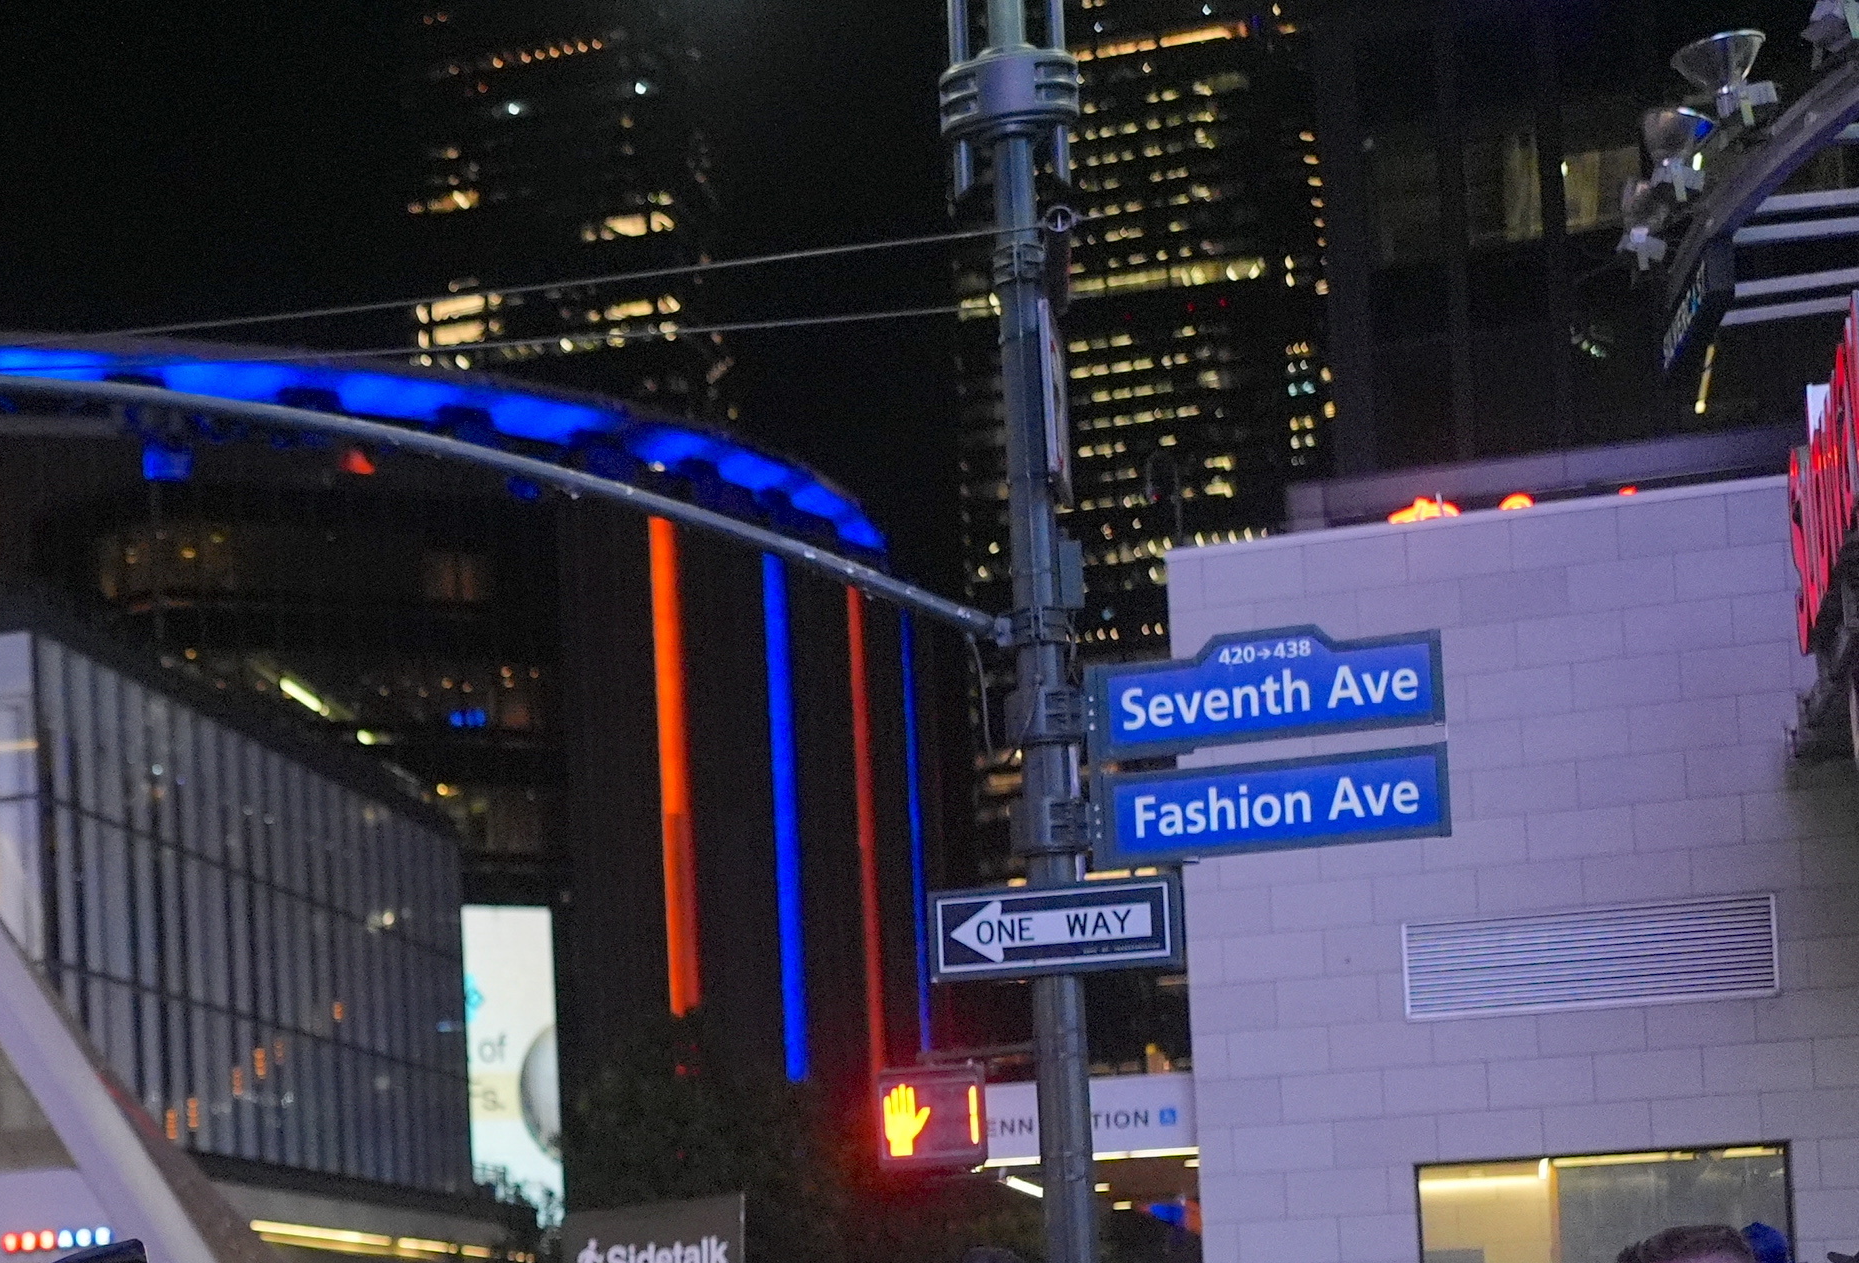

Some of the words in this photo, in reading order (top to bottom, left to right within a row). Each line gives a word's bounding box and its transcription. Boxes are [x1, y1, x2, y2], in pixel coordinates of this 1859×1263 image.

[1218, 646, 1256, 665] 420
[1273, 640, 1311, 658] 438
[1121, 668, 1311, 731] Seventh
[1327, 665, 1419, 709] Ave
[1134, 785, 1312, 838] Fashion
[1328, 777, 1420, 820] Ave
[976, 918, 1035, 945] ONE
[1066, 909, 1131, 938] WAY
[987, 1116, 1034, 1138] ENN
[1092, 1109, 1149, 1130] TION
